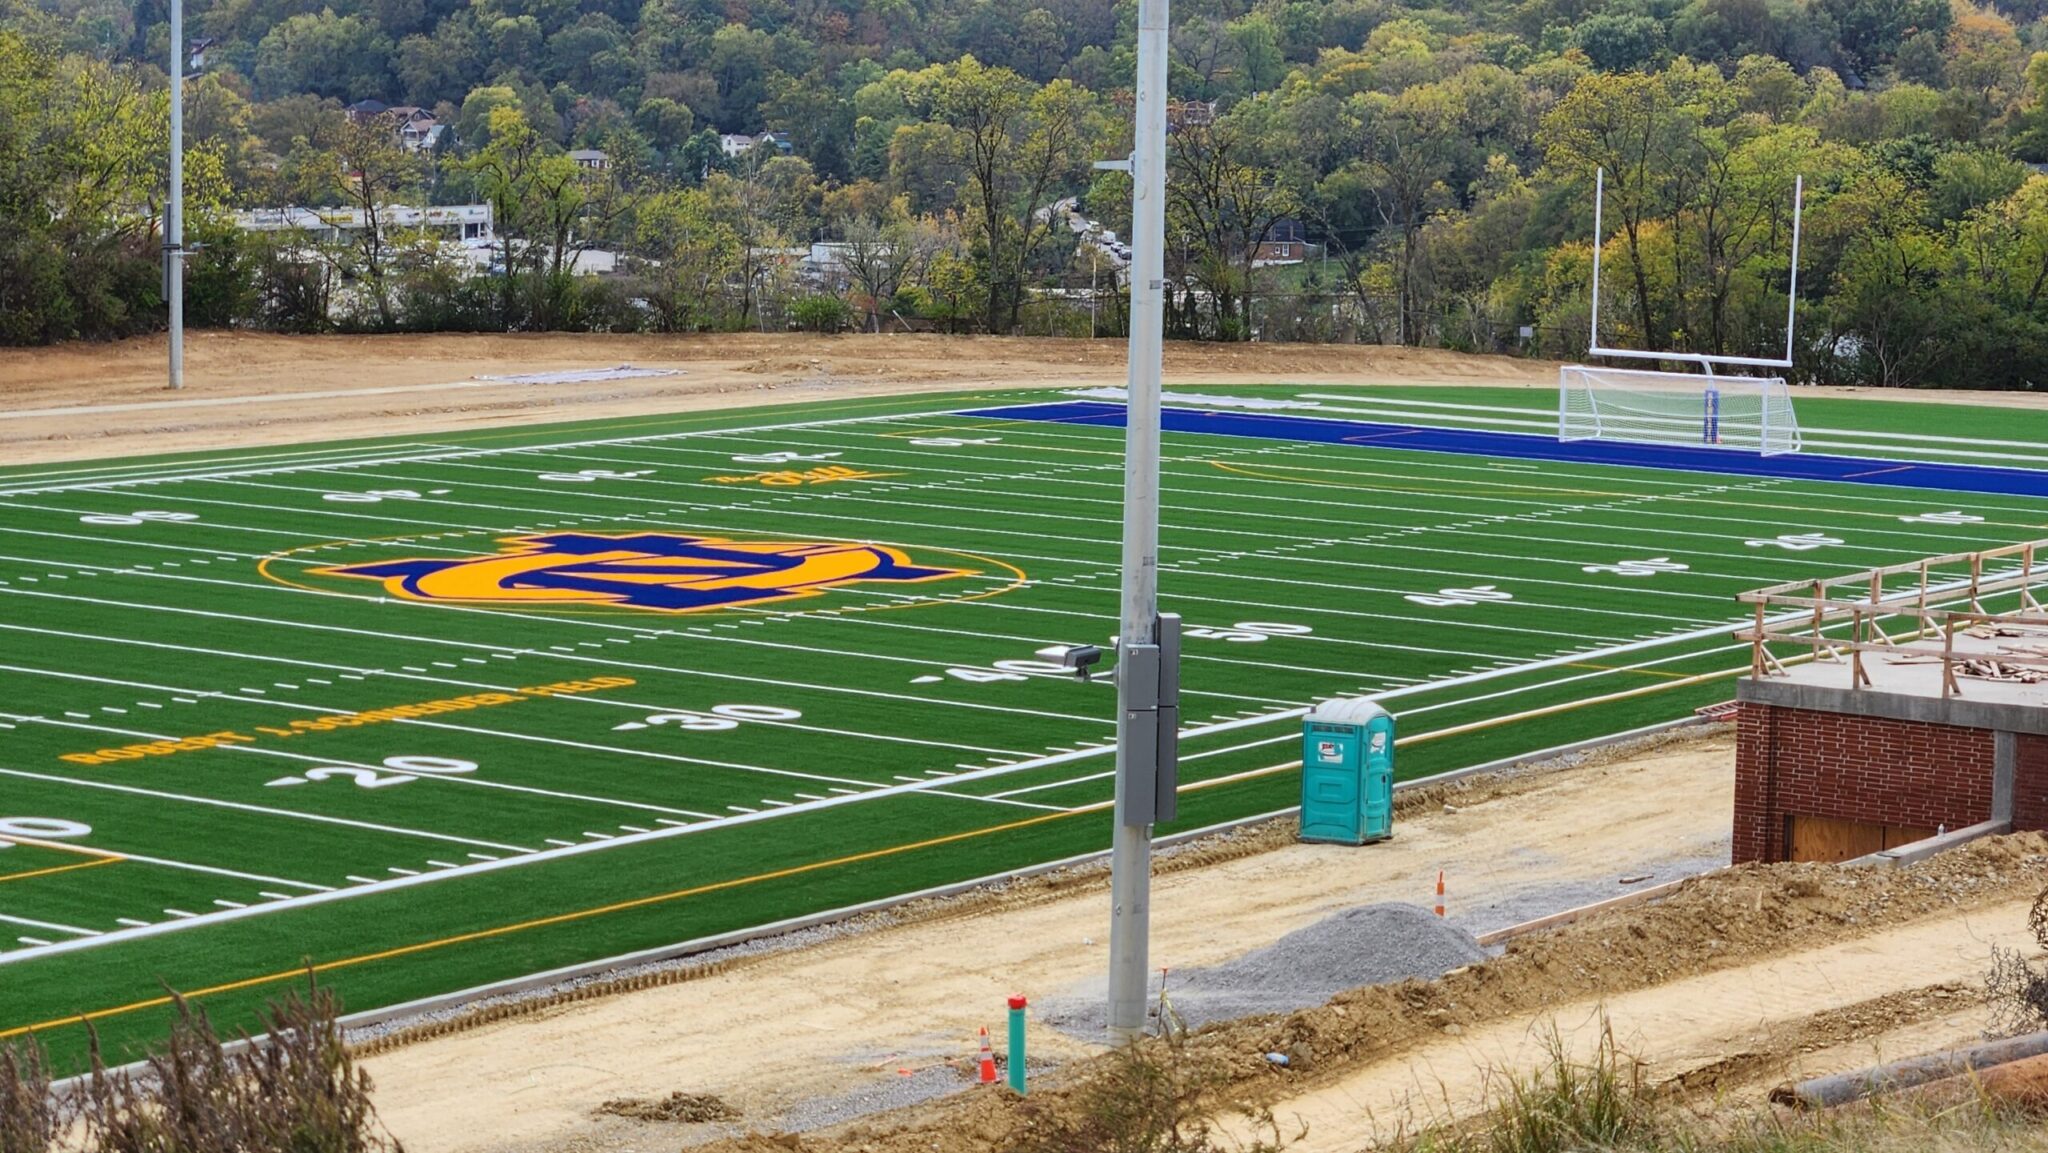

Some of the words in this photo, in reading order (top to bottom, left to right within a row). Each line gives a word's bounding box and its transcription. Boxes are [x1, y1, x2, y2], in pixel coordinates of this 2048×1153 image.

[1745, 535, 1845, 550] 20
[1582, 560, 1690, 576] 30
[1403, 588, 1513, 606] 40
[1181, 622, 1313, 642] 50
[945, 660, 1078, 682] 40
[645, 704, 802, 730] 30
[58, 731, 256, 764] ROBERT
[305, 755, 479, 788] 20
